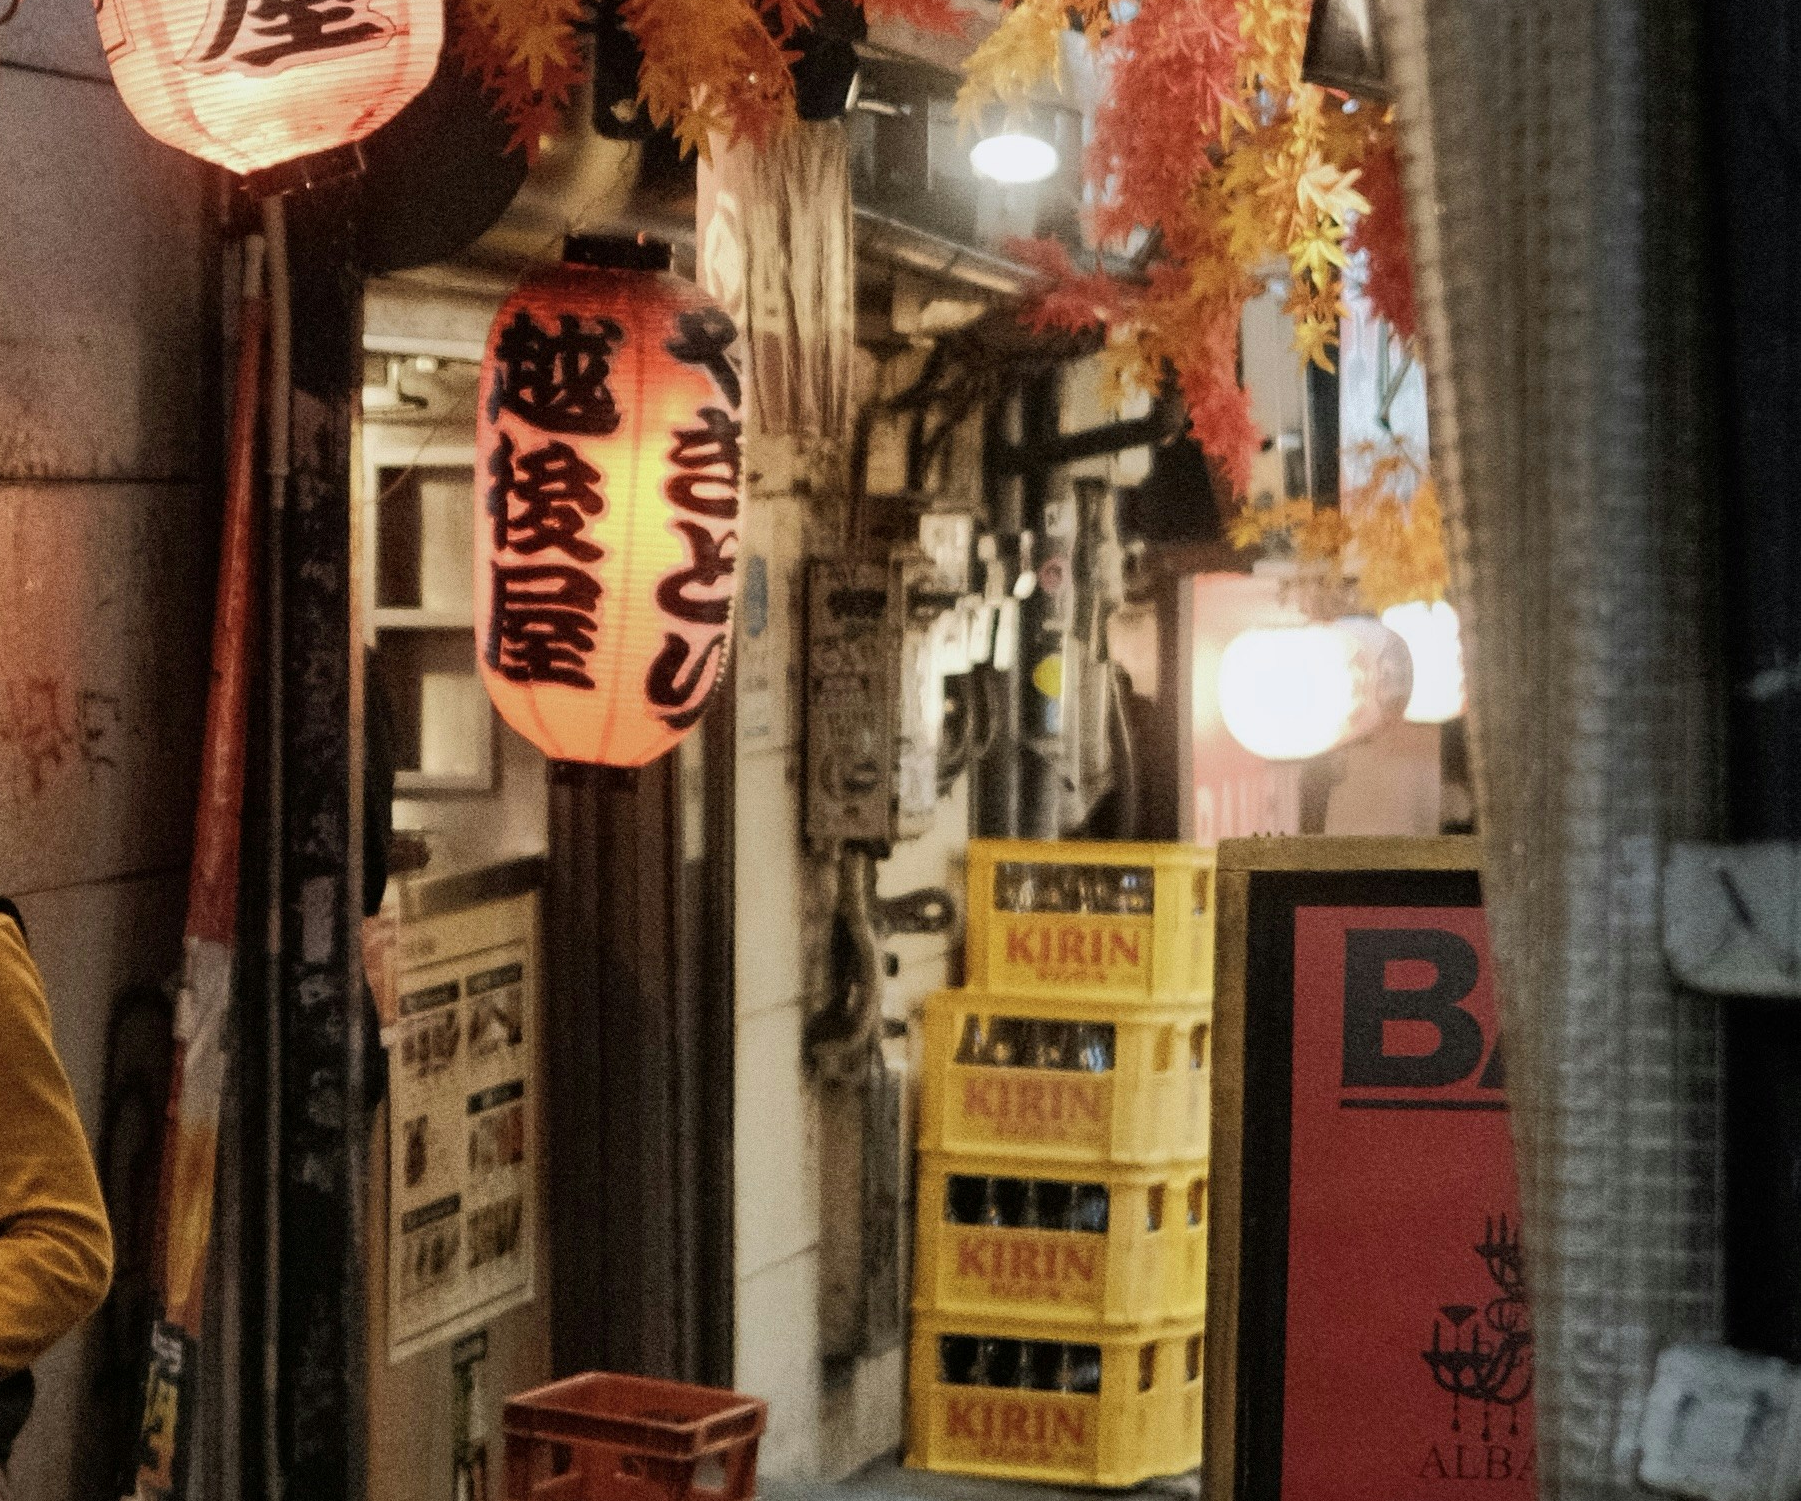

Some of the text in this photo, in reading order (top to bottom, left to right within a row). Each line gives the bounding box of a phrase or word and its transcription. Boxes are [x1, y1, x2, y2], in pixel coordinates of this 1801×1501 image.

[486, 308, 633, 692] 越後屋
[645, 306, 744, 732] やきとり
[1004, 925, 1140, 966] KIRIN
[1341, 927, 1506, 1090] B
[962, 1076, 1102, 1121] KIRIN
[955, 1235, 1096, 1282] KIRIN
[945, 1398, 1085, 1445] KIRIN
